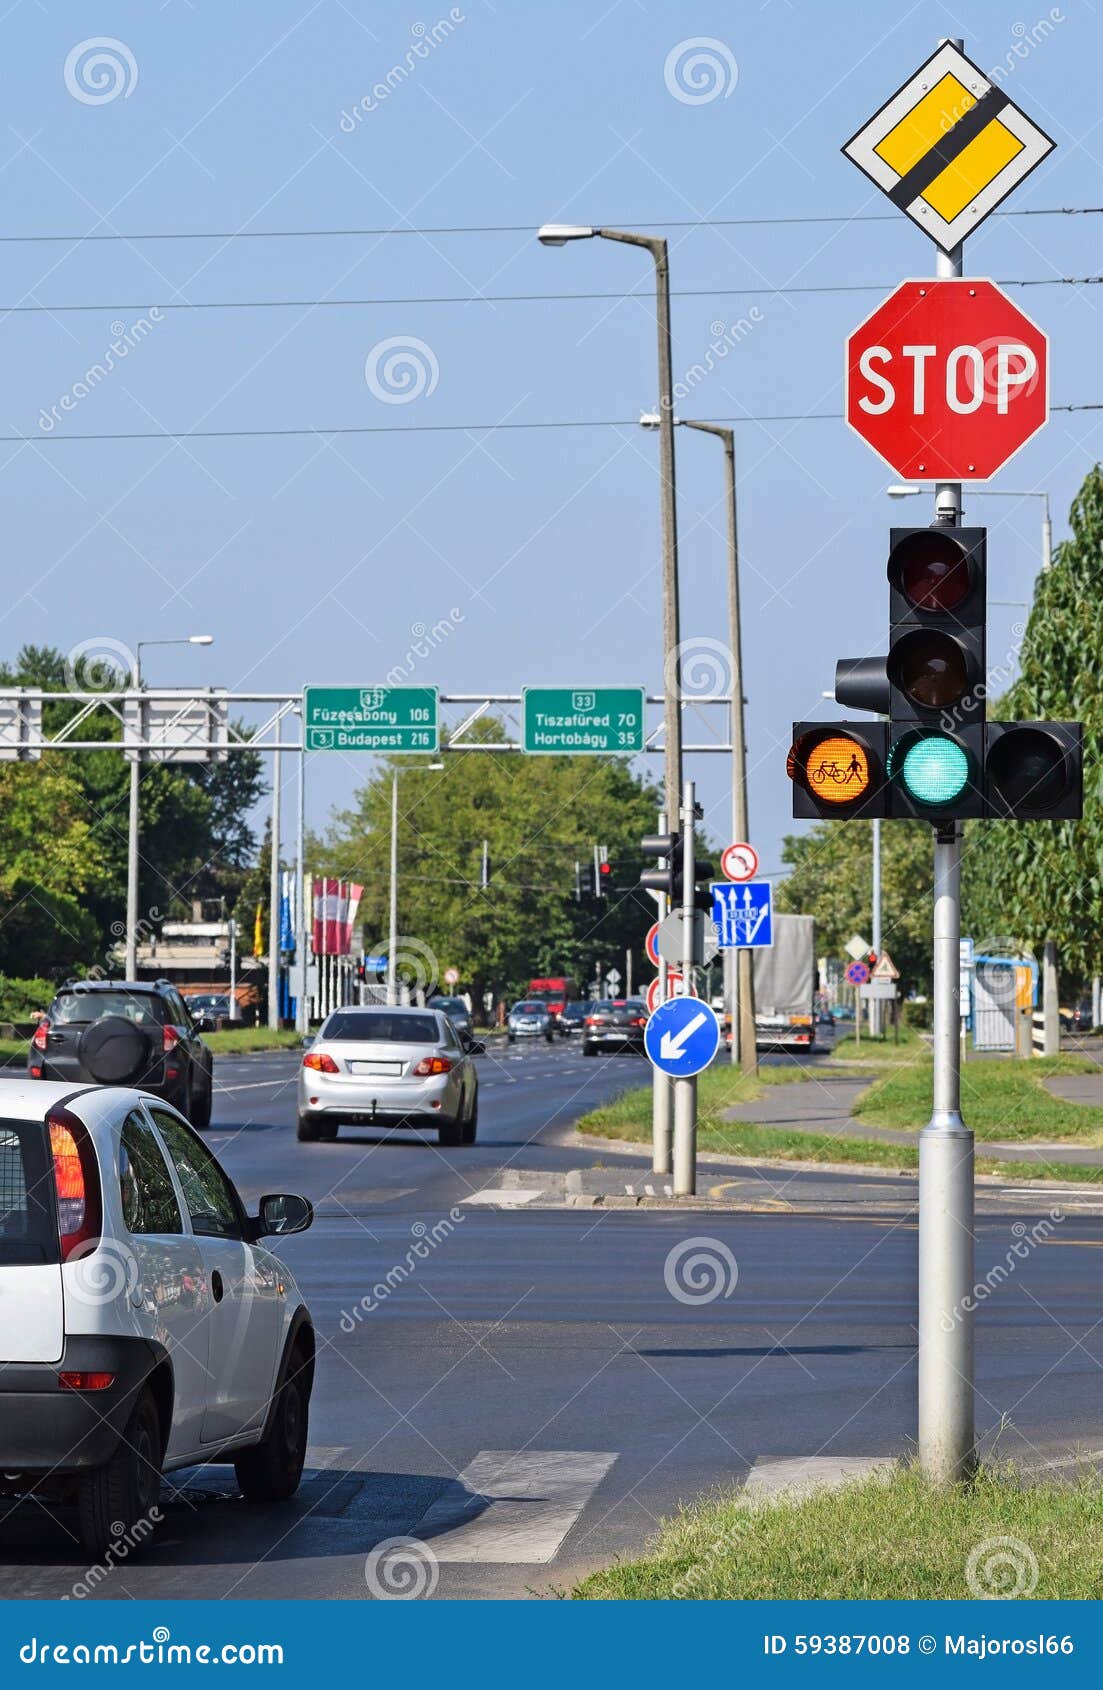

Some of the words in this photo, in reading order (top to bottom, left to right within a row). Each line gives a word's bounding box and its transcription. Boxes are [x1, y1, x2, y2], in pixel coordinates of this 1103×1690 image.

[858, 345, 1037, 415] STOP
[576, 695, 591, 707] 33
[409, 708, 430, 721] 106
[535, 713, 610, 727] Tiszafüred
[617, 713, 636, 727] 70
[319, 733, 327, 744] 3
[337, 732, 403, 748] Budapest
[410, 732, 430, 746] 216
[534, 732, 608, 748] Hortobágy
[617, 732, 636, 745] 35
